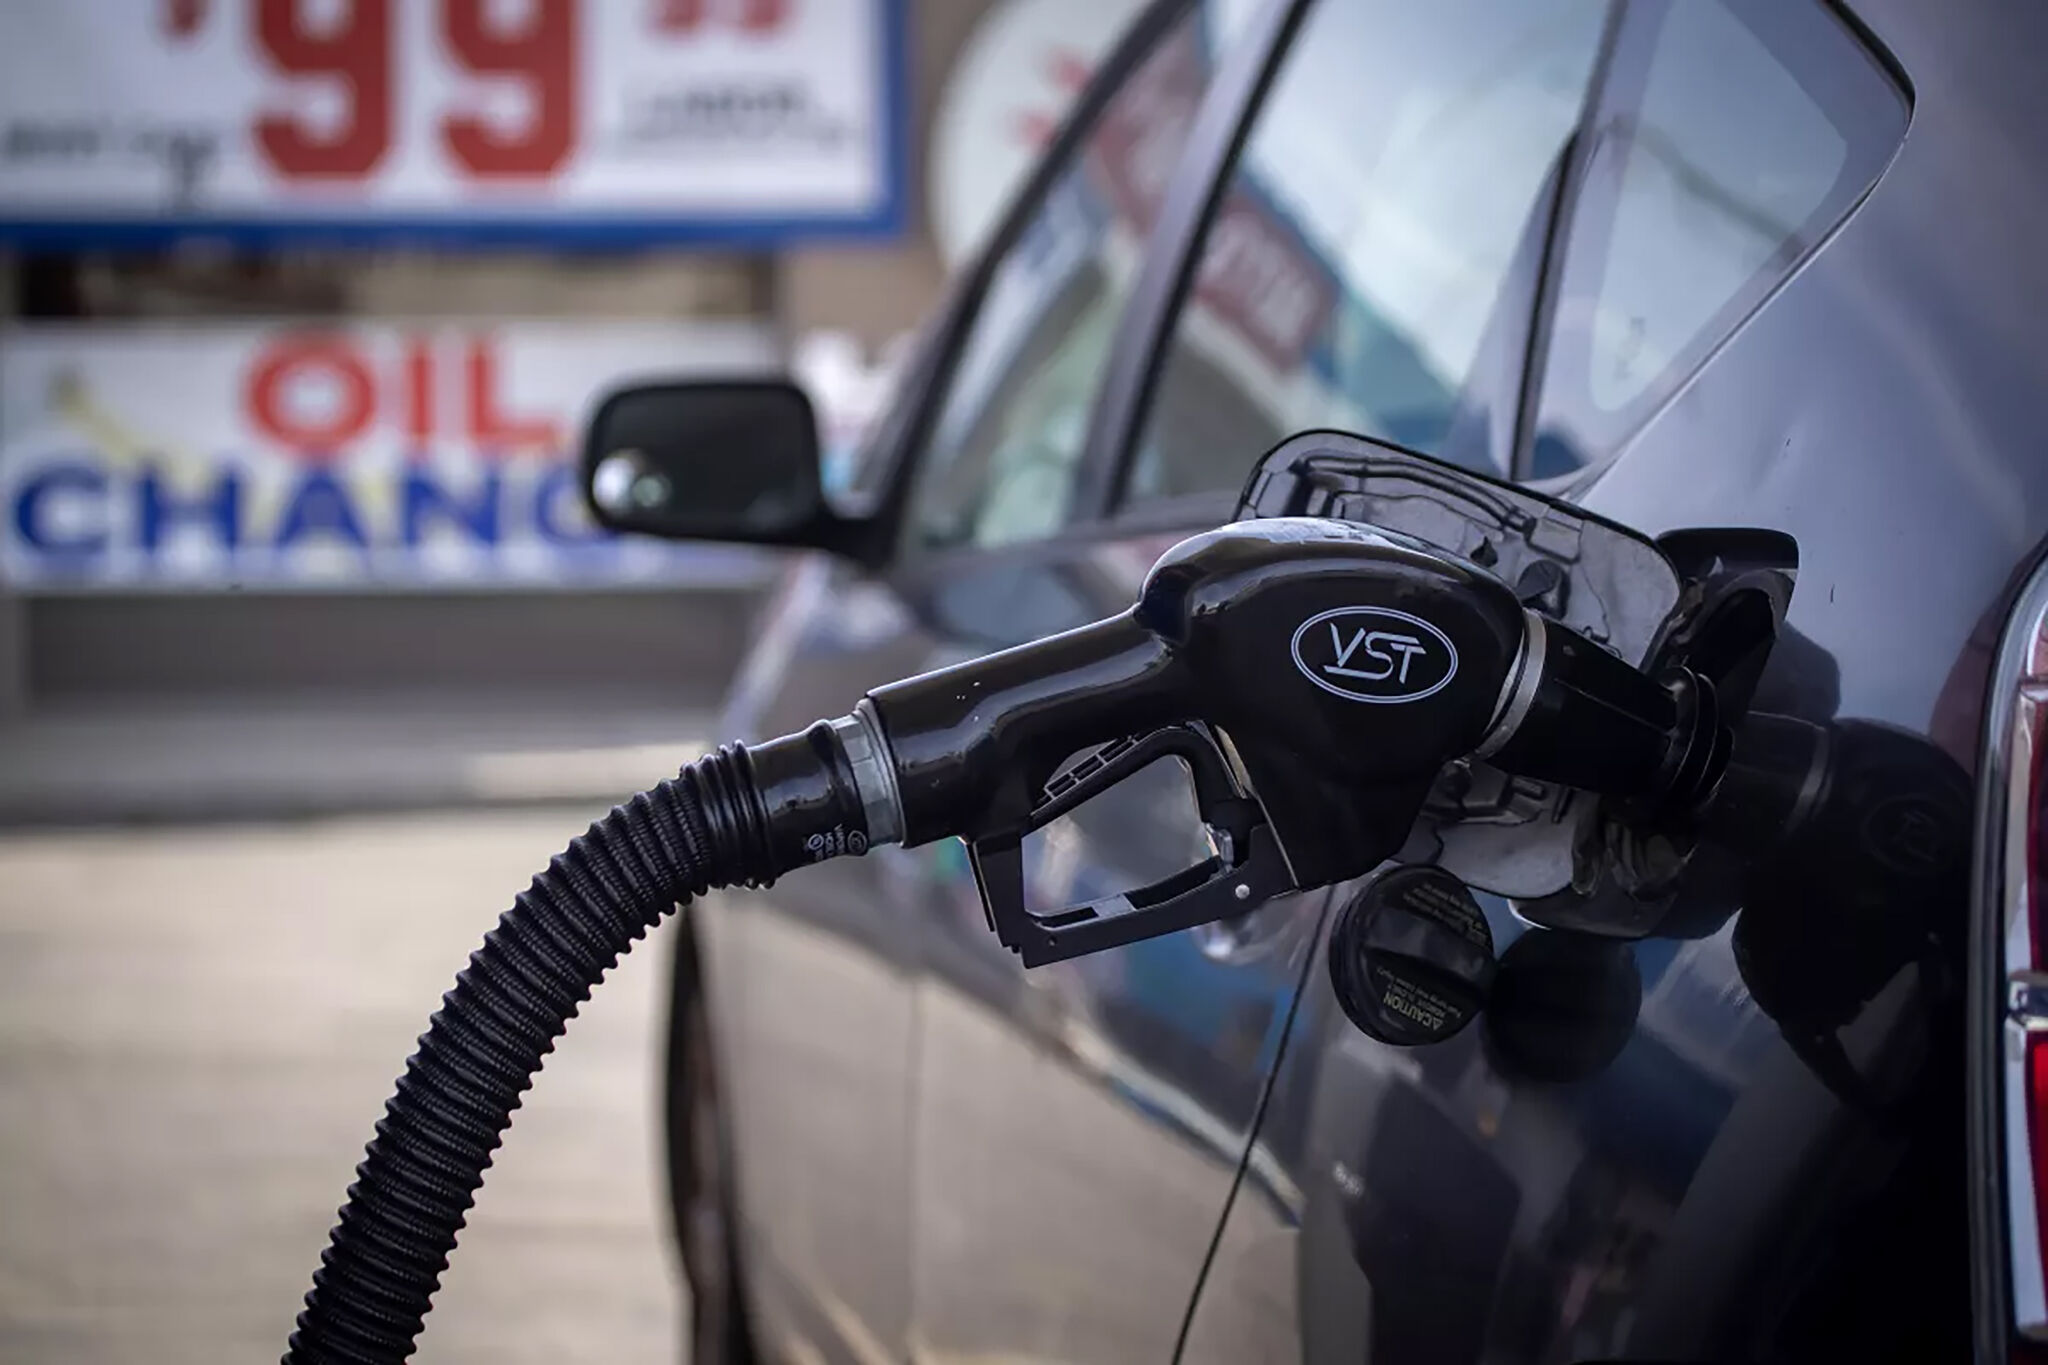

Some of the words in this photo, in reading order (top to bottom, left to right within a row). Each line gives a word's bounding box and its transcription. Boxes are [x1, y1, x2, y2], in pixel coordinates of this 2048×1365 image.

[243, 334, 560, 456] OIL
[1323, 622, 1427, 684] VST
[1383, 991, 1433, 1027] CAUTION
